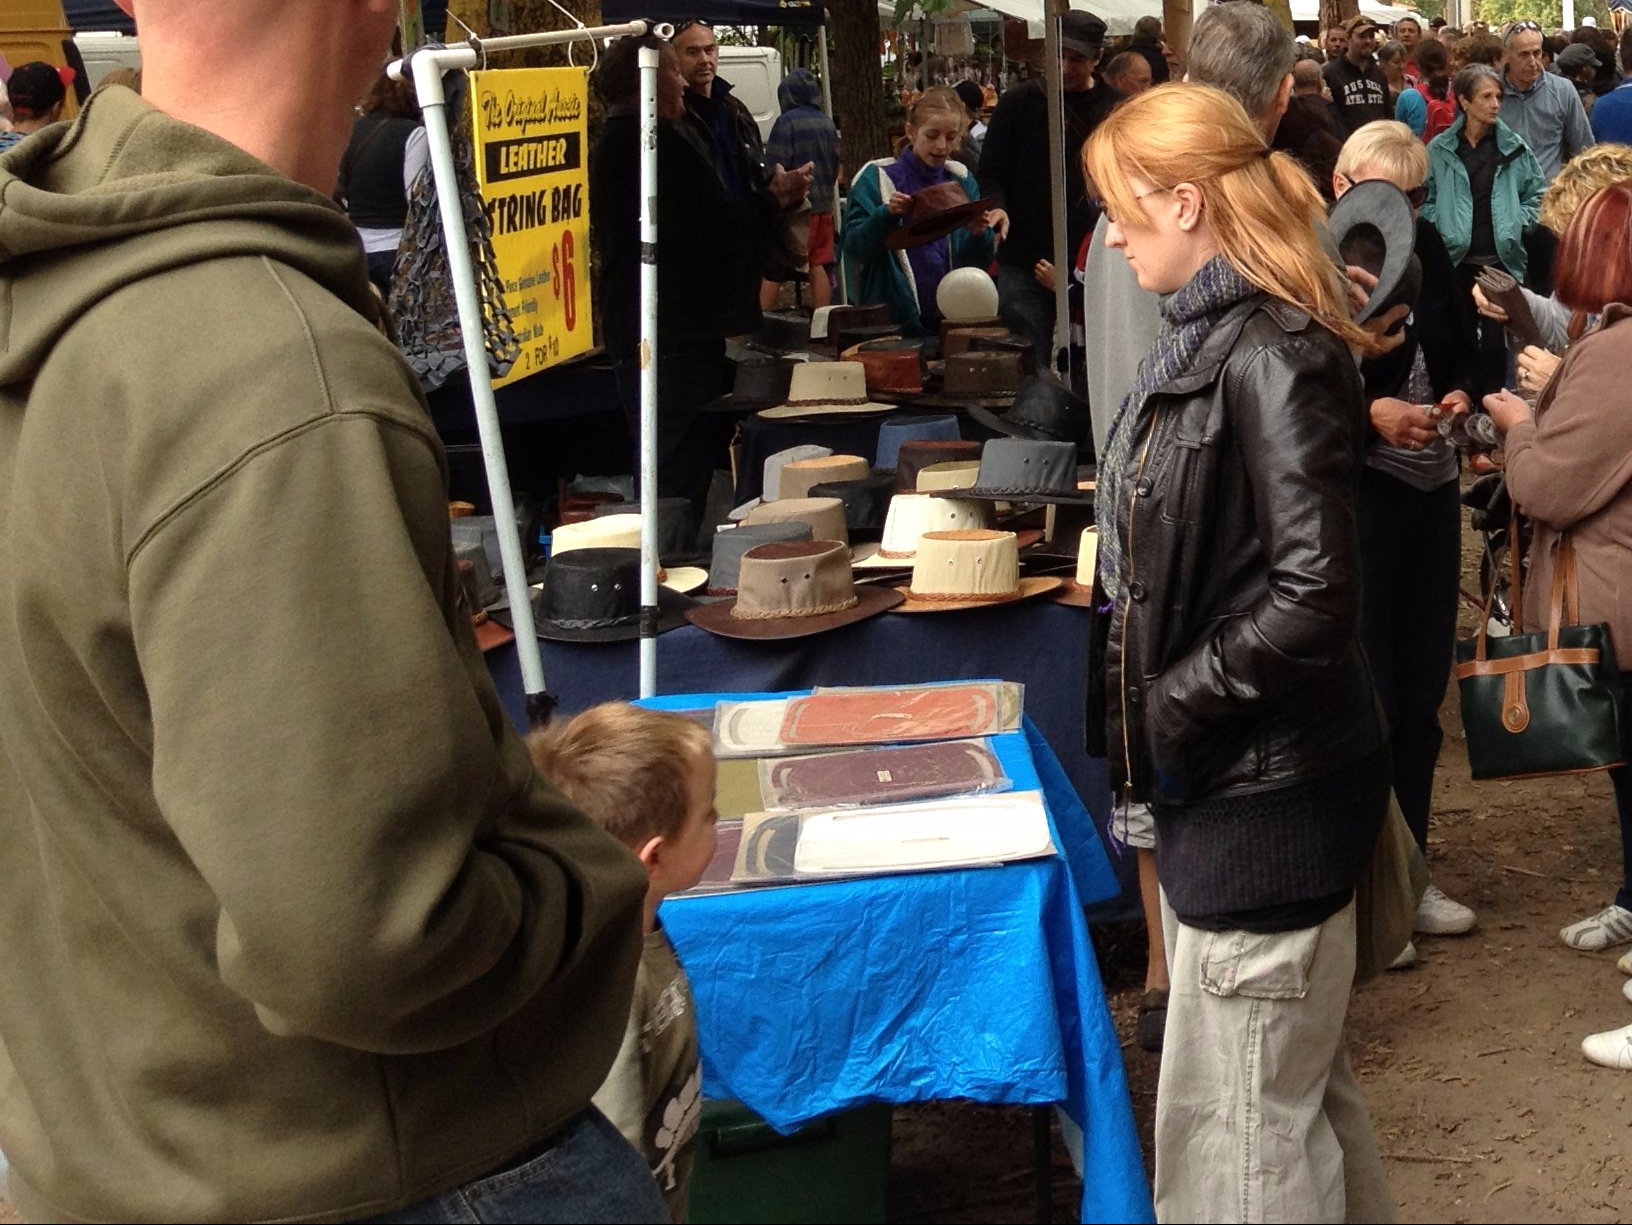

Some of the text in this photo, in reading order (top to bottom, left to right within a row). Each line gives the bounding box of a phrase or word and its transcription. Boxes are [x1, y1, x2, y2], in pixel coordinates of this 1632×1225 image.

[482, 90, 502, 131] The
[500, 138, 567, 174] LEATHER
[487, 183, 583, 237] STRING BAG
[535, 344, 548, 366] FOR
